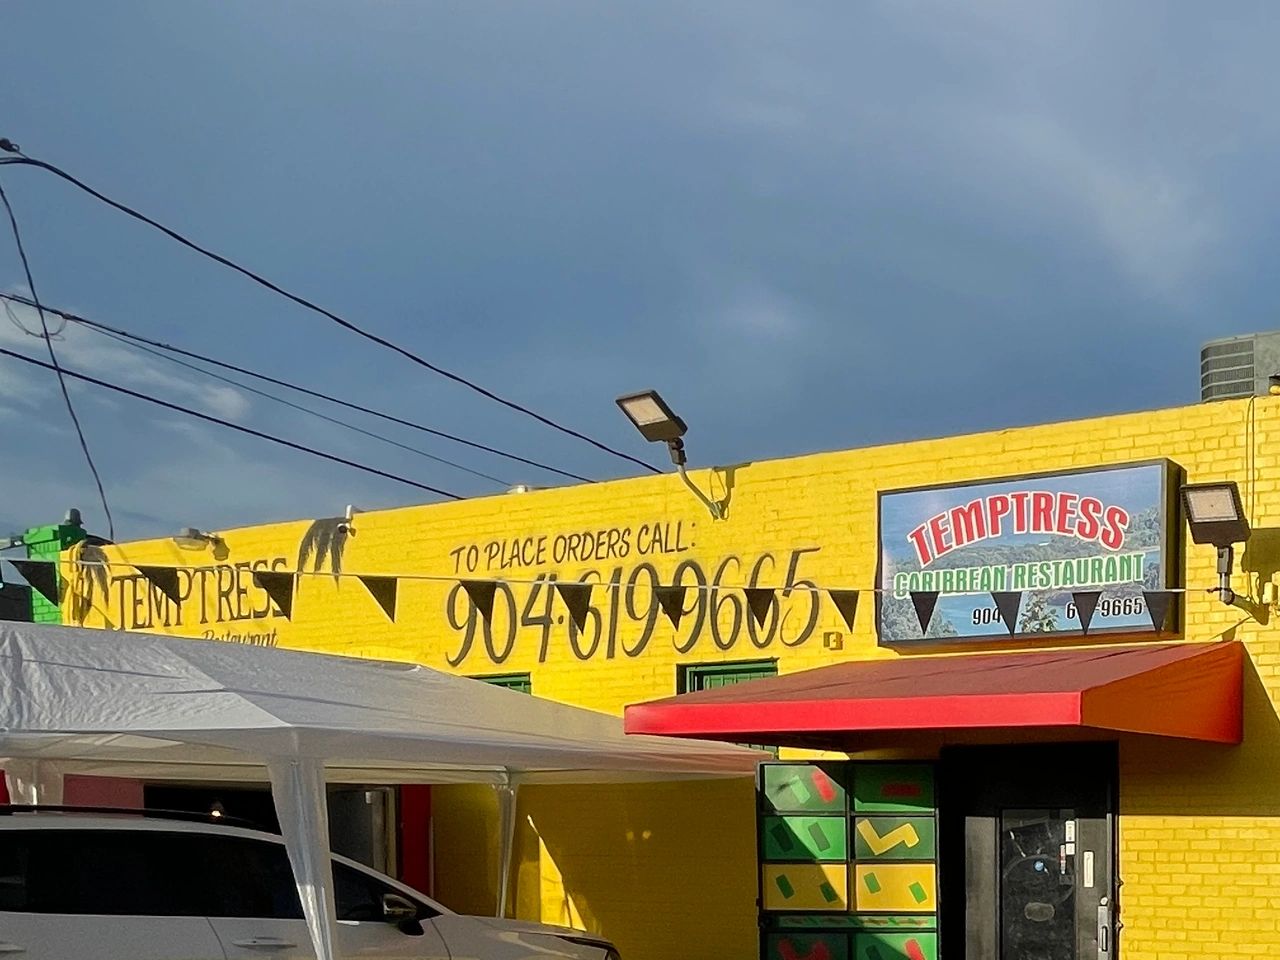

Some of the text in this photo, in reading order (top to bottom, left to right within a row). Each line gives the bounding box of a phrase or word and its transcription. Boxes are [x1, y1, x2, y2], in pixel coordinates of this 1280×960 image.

[450, 521, 697, 574] TO PLACE ORDERS CALL:
[906, 490, 1130, 569] TEMPTRESS
[893, 551, 1146, 600] CARIBBEAN RESTAURANT
[1066, 597, 1143, 620] 6-9665
